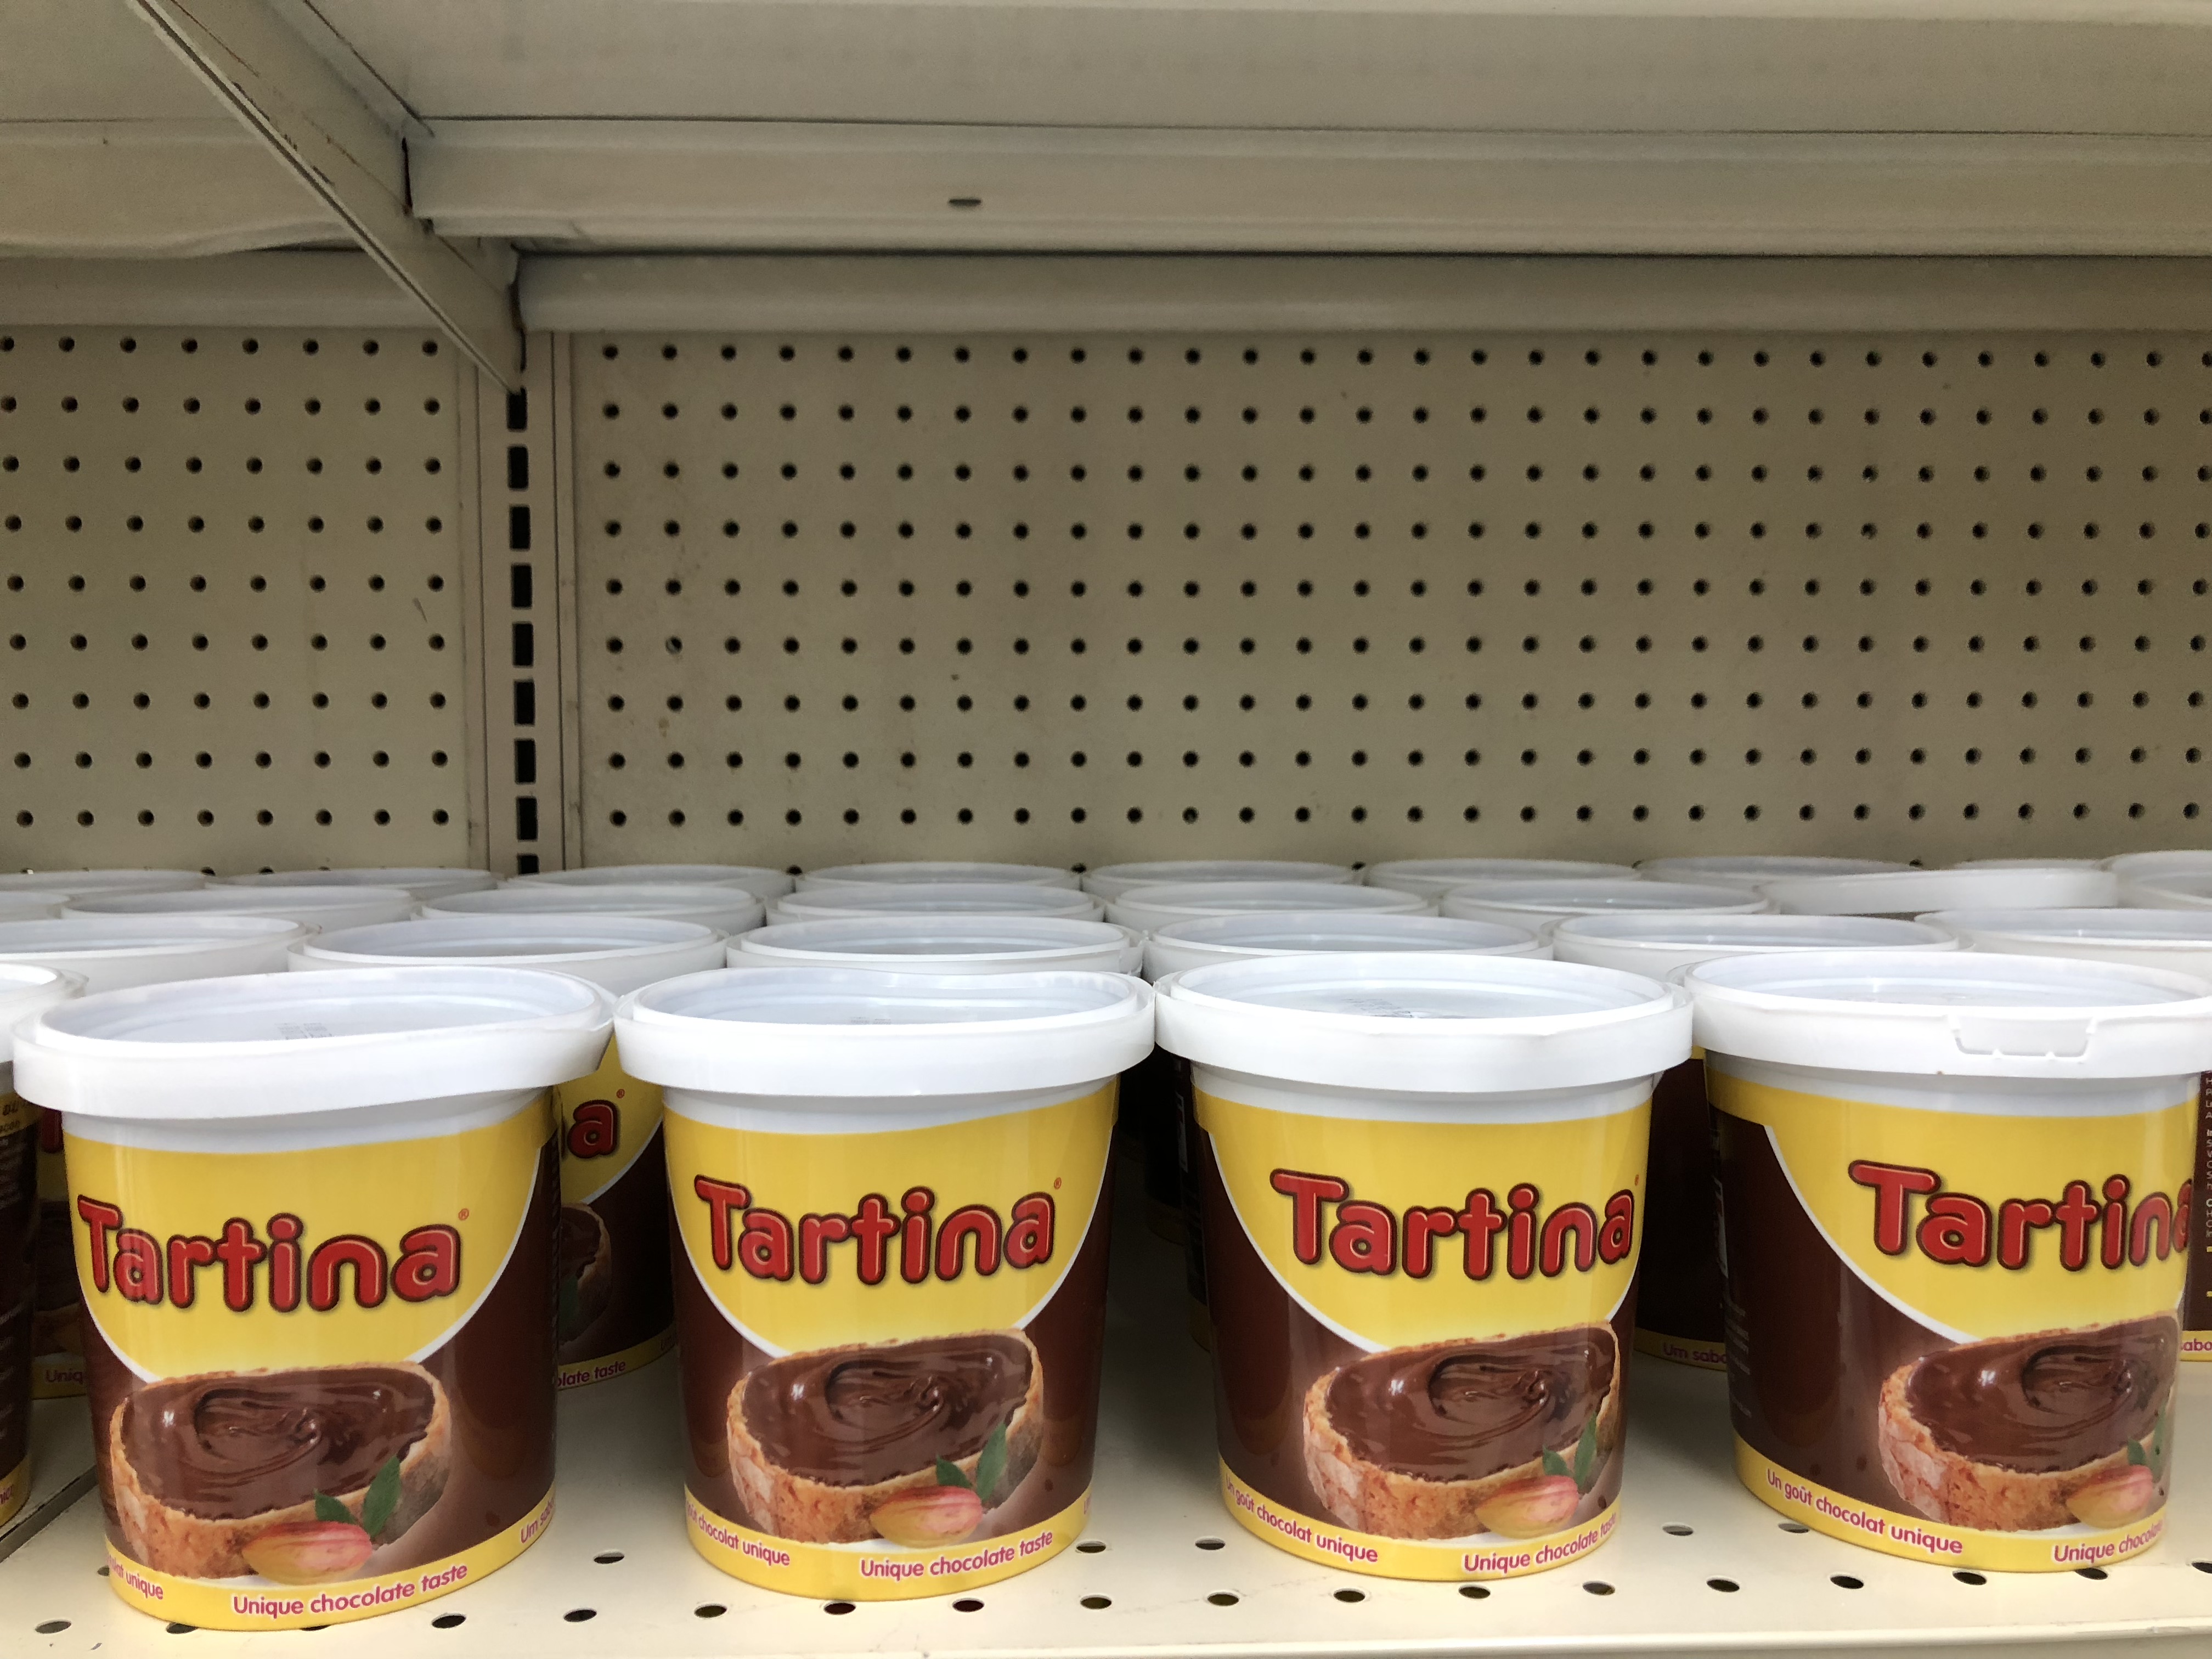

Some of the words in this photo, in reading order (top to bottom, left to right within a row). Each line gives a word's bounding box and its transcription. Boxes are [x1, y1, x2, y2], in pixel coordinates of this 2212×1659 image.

[695, 1175, 1056, 1285] Tartina
[1269, 1168, 1635, 1280] Tartina
[77, 1194, 461, 1313] Tartina
[1663, 1342, 1688, 1359] Um
[2182, 1338, 2212, 1351] abo
[594, 1361, 626, 1379] taste
[521, 1520, 538, 1543] Um
[1235, 1489, 1255, 1513] goût
[1257, 1504, 1312, 1543] chocolat
[1316, 1534, 1378, 1562] unique
[1767, 1469, 1781, 1491] Un
[1785, 1482, 1812, 1506] goût
[1816, 1497, 1886, 1534] chocolat
[1891, 1526, 1963, 1554] unique
[699, 1514, 739, 1549] chocolat
[743, 1541, 790, 1566] unique
[861, 1559, 924, 1581] Unique
[930, 1547, 1014, 1575] chocolate
[1019, 1531, 1053, 1556] taste
[1464, 1553, 1530, 1573] Unique
[1536, 1530, 1598, 1564] chocolate
[2055, 1543, 2115, 1564] Unique
[126, 1571, 163, 1600] unique
[233, 1596, 303, 1619] Unique
[311, 1582, 415, 1613] chocolate
[422, 1565, 467, 1592] taste
